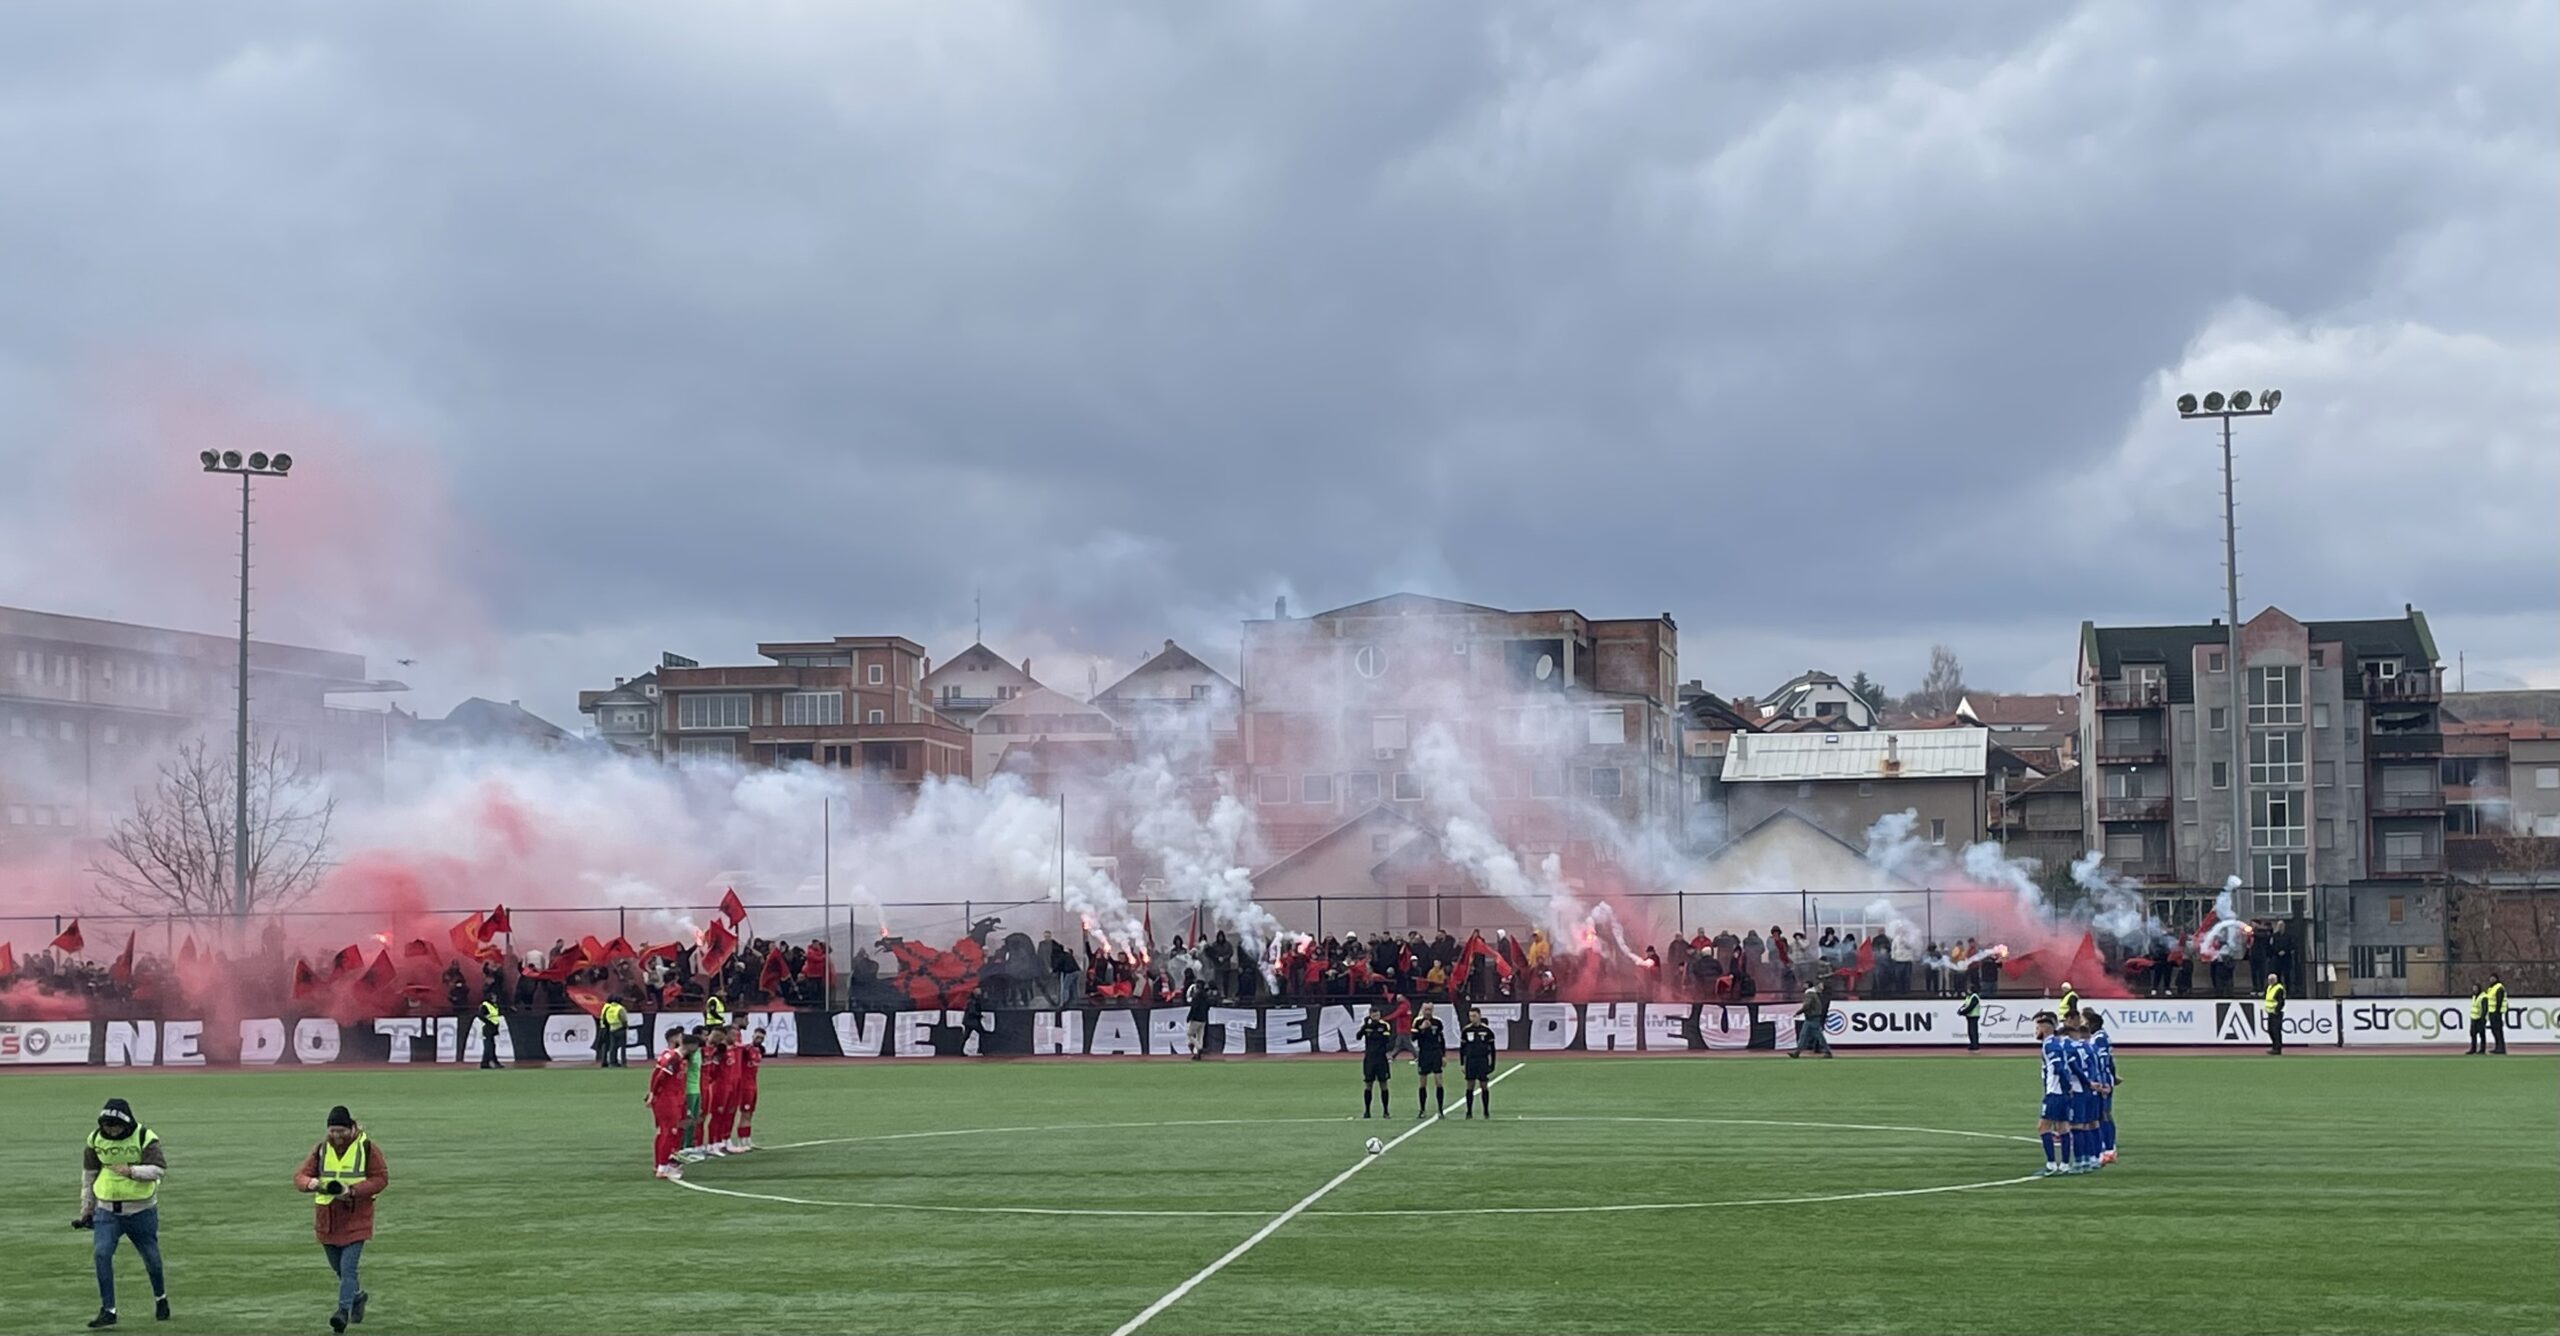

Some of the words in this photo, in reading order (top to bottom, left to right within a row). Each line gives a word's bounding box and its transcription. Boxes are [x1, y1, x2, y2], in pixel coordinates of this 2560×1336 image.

[1851, 1012, 1932, 1032] SOLIN
[2118, 1010, 2194, 1023] TEUTA-M
[2260, 1009, 2332, 1034] tade
[2353, 1003, 2463, 1039] straga
[104, 1020, 206, 1066] NE
[239, 1018, 341, 1065] DO
[832, 1008, 995, 1057] VET
